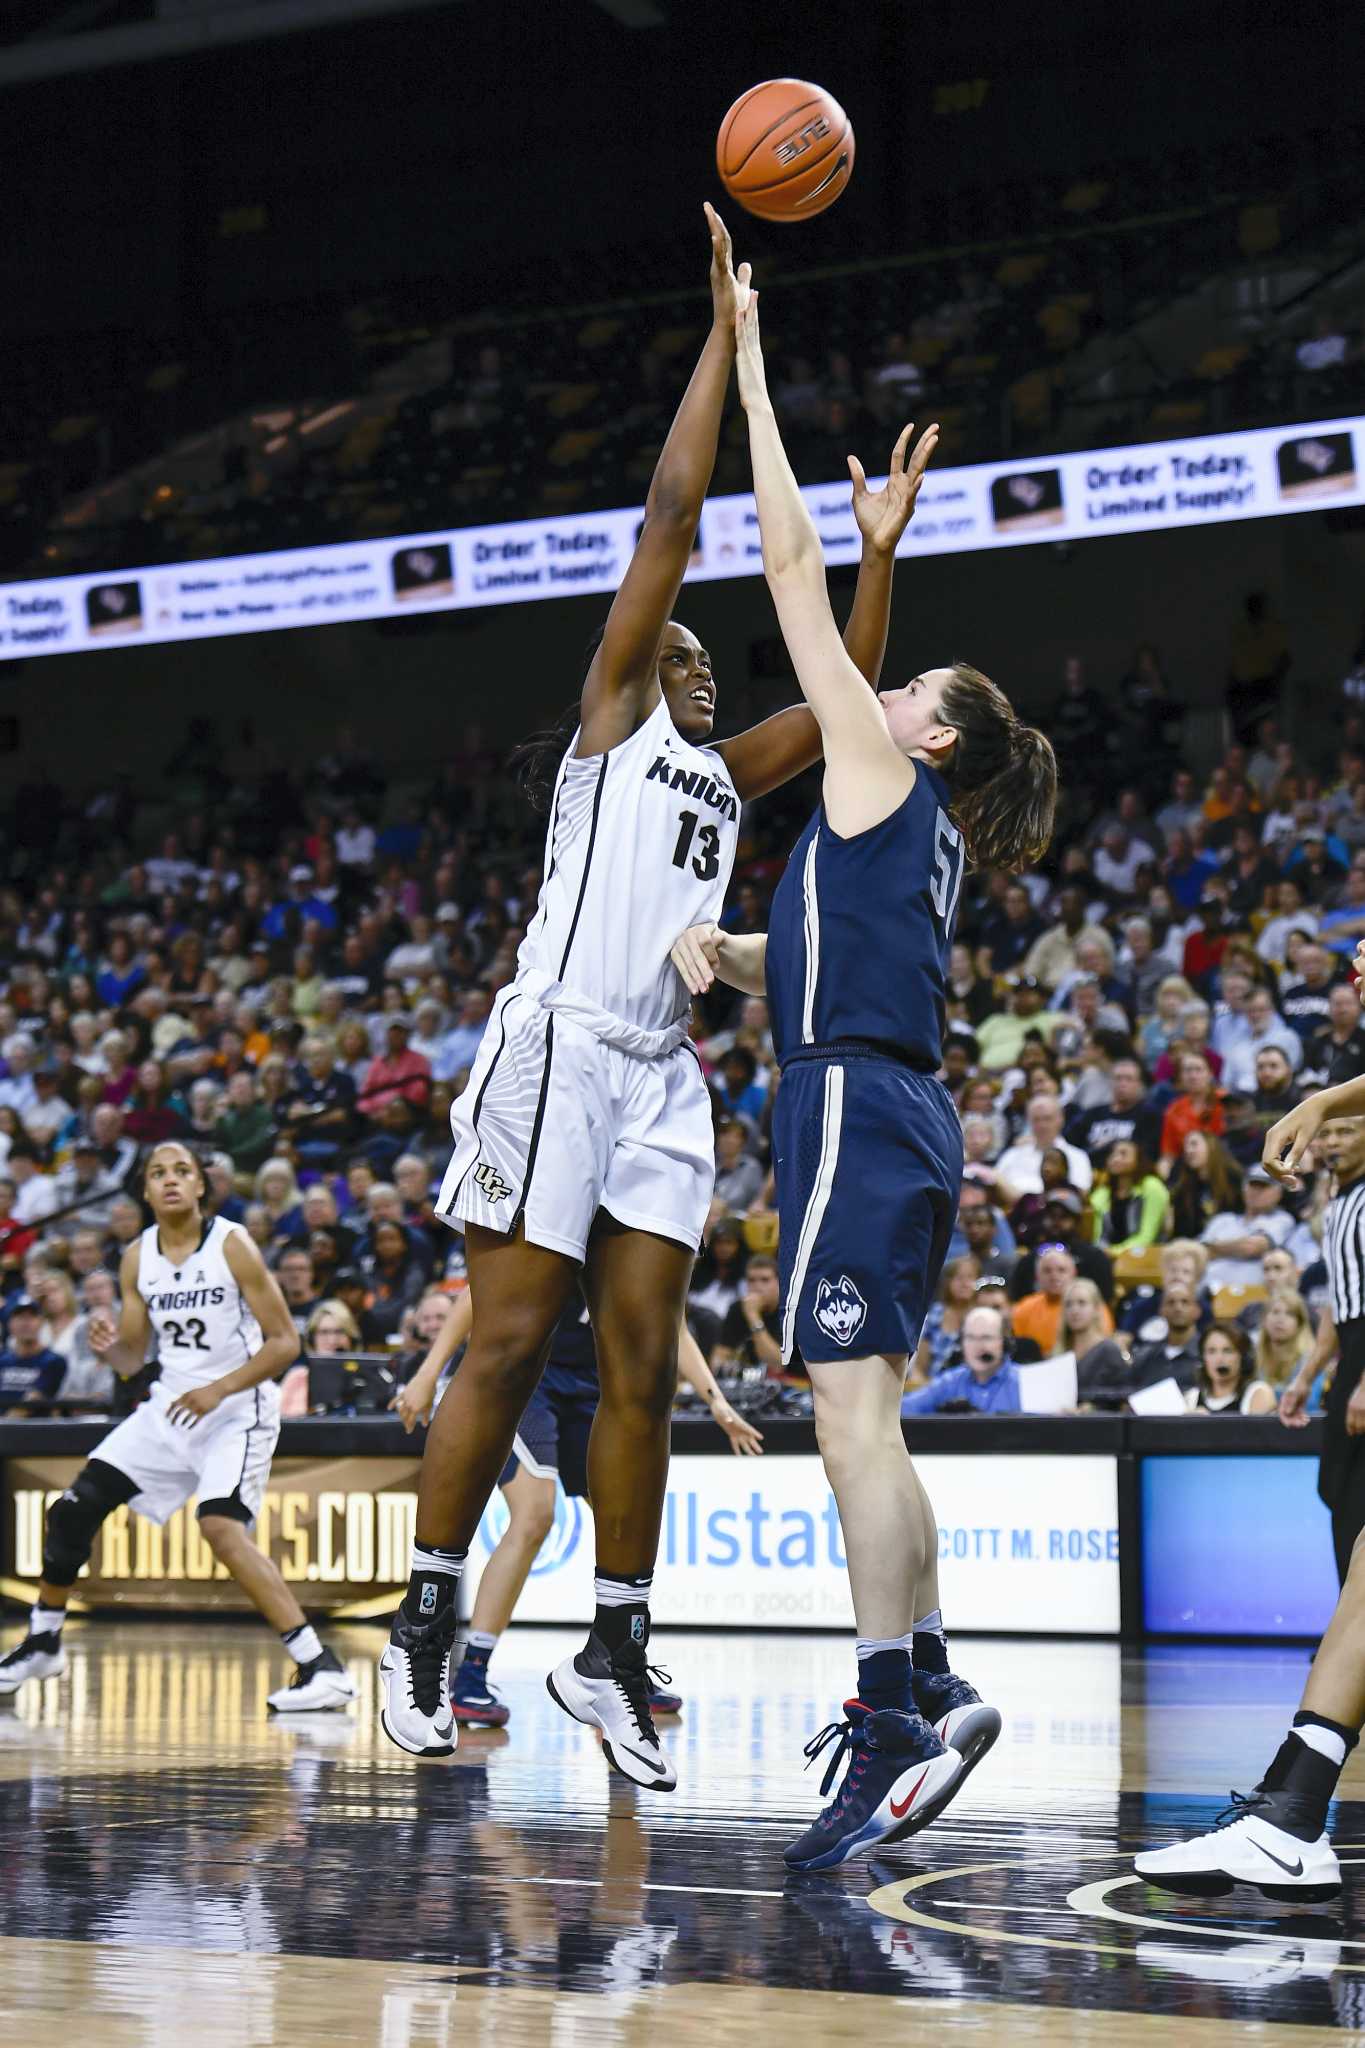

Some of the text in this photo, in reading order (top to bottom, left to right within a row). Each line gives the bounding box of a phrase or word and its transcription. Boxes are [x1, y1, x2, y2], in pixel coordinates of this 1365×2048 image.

[672, 810, 720, 881] 13
[474, 1162, 514, 1204] UCF
[163, 1317, 211, 1351] 22
[665, 1492, 847, 1568] llstat
[936, 1528, 1120, 1561] COTT M. ROSE
[753, 1585, 814, 1618] good
